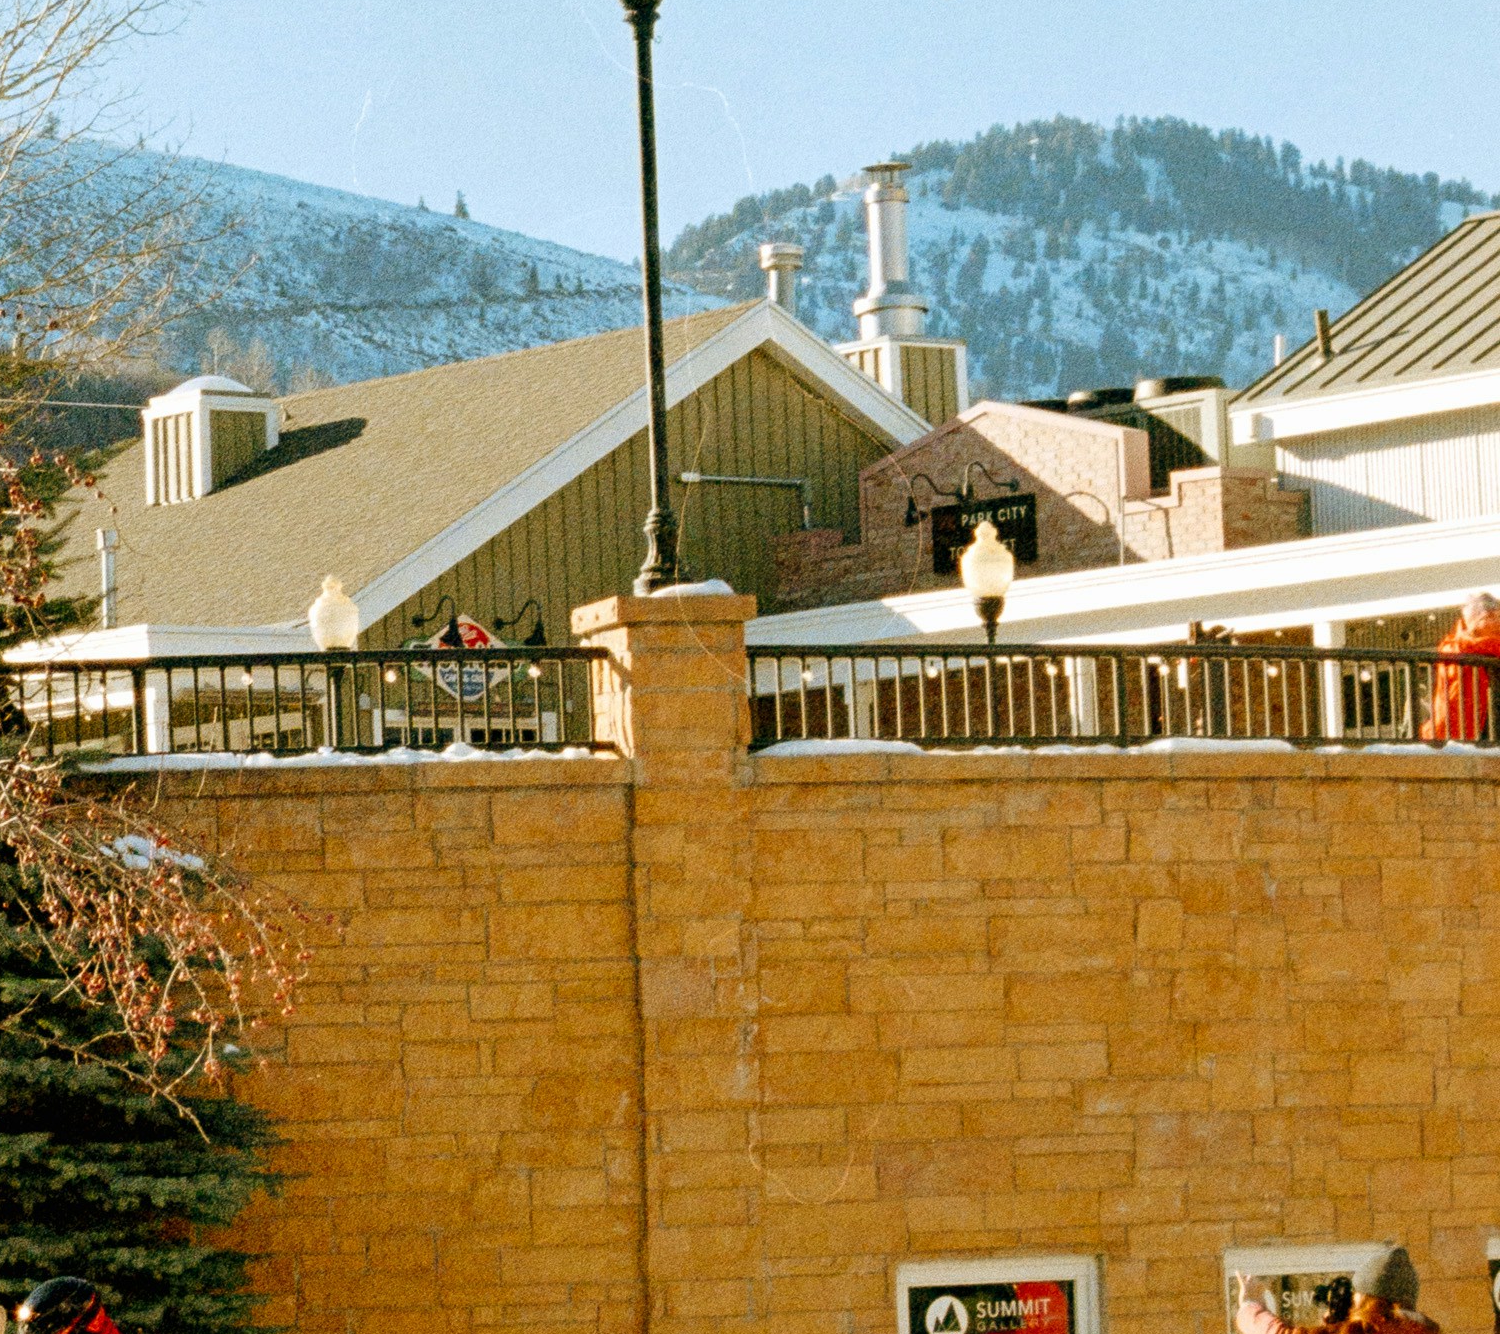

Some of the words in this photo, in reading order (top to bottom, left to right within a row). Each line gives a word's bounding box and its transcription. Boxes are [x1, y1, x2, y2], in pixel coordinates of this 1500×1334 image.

[962, 511, 993, 527] PARK
[997, 506, 1027, 521] CITY
[976, 1298, 1050, 1318] SUMMIT
[977, 1318, 1050, 1332] GALLERY
